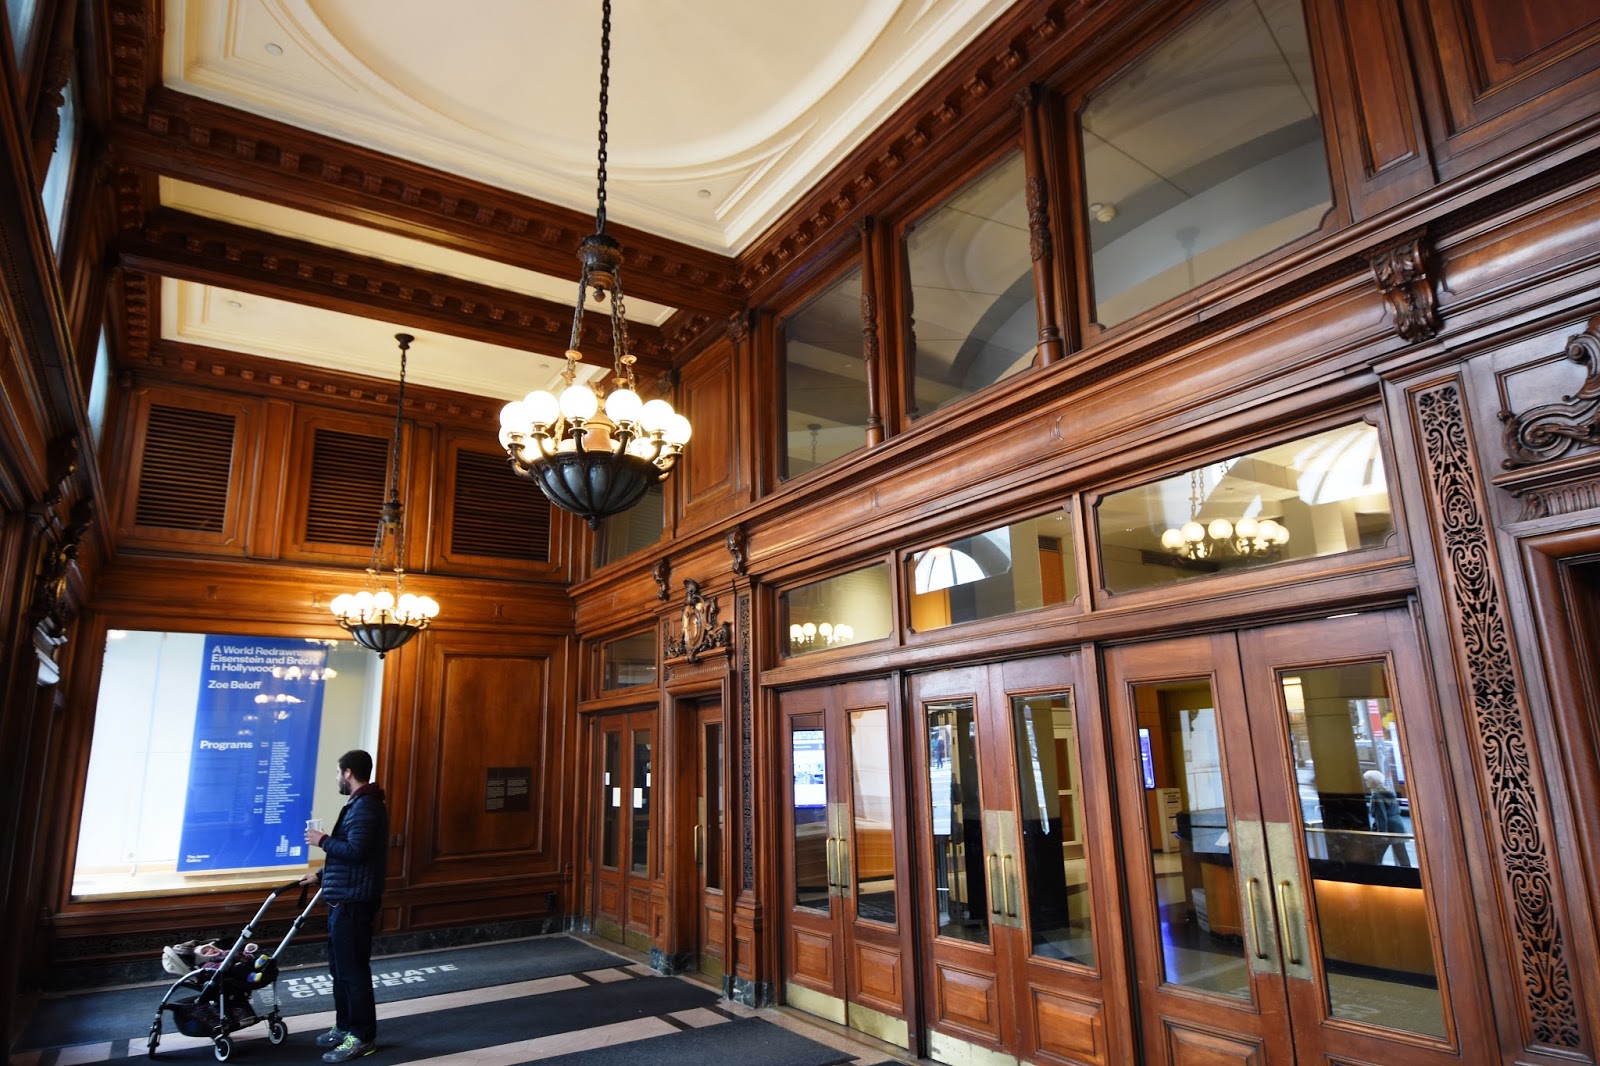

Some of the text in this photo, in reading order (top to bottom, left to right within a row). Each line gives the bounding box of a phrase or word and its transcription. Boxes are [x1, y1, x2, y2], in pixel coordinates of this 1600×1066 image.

[212, 645, 221, 654] A
[223, 645, 254, 655] World
[211, 653, 320, 666] Eisenstein and Brecht
[210, 662, 220, 671] in
[207, 679, 263, 690] Zoe Beloff
[200, 740, 253, 751] Programs
